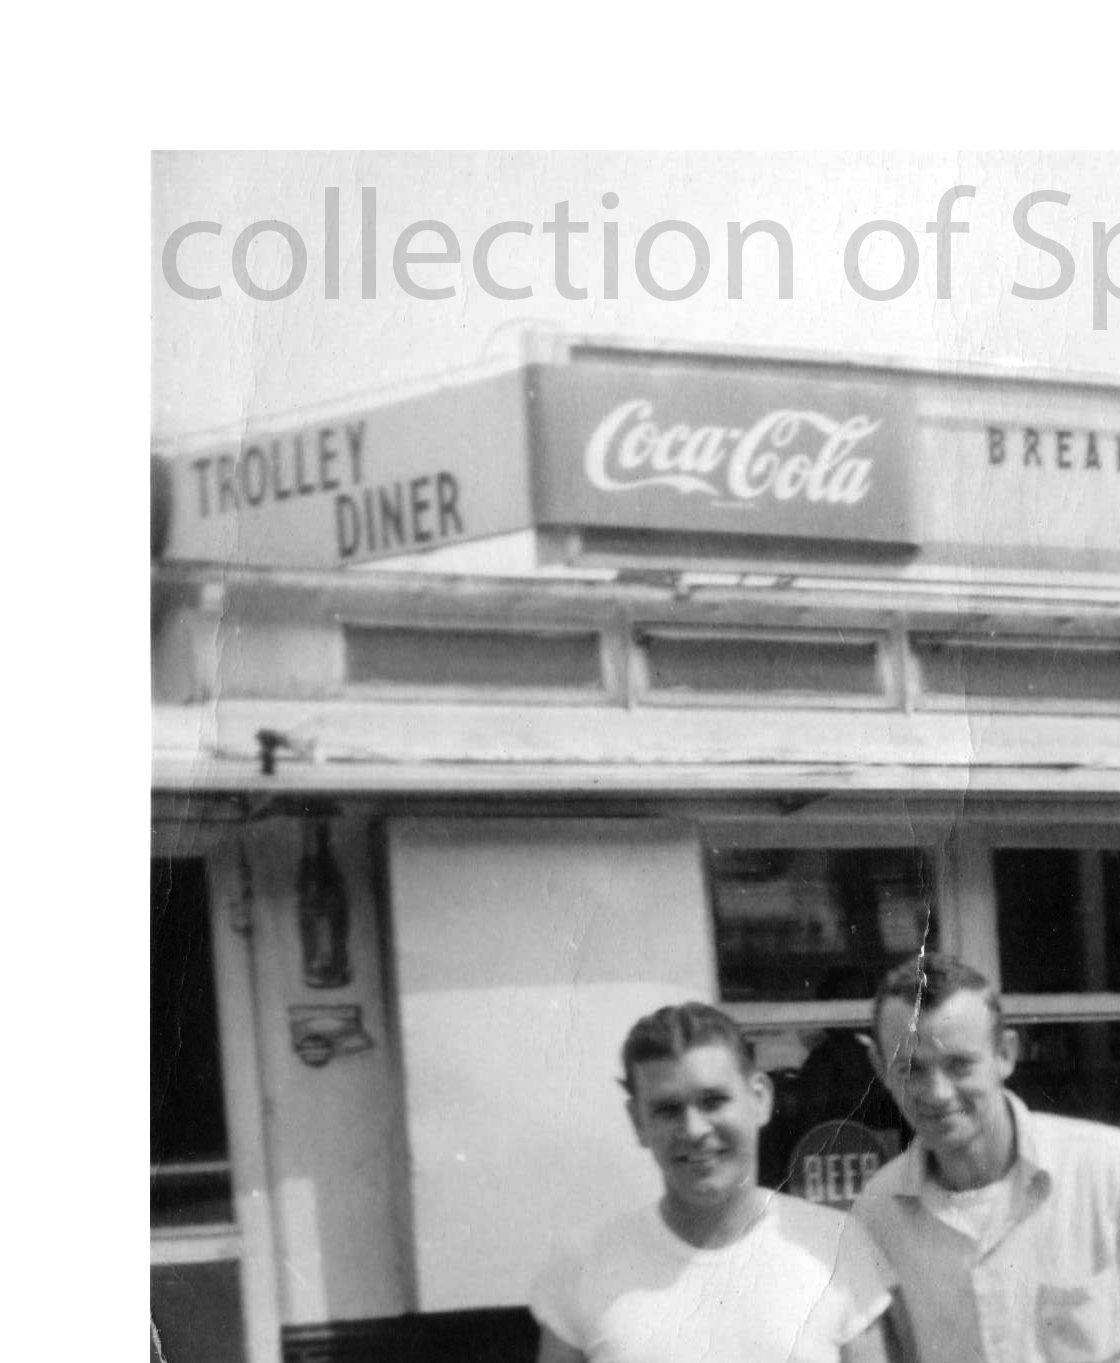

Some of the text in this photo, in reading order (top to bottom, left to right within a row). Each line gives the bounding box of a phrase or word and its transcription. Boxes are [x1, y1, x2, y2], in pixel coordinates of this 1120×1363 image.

[191, 419, 367, 521] TROLLEY
[583, 397, 886, 505] Coca-Cola
[334, 469, 463, 560] DINER
[802, 1152, 879, 1202] BEER
